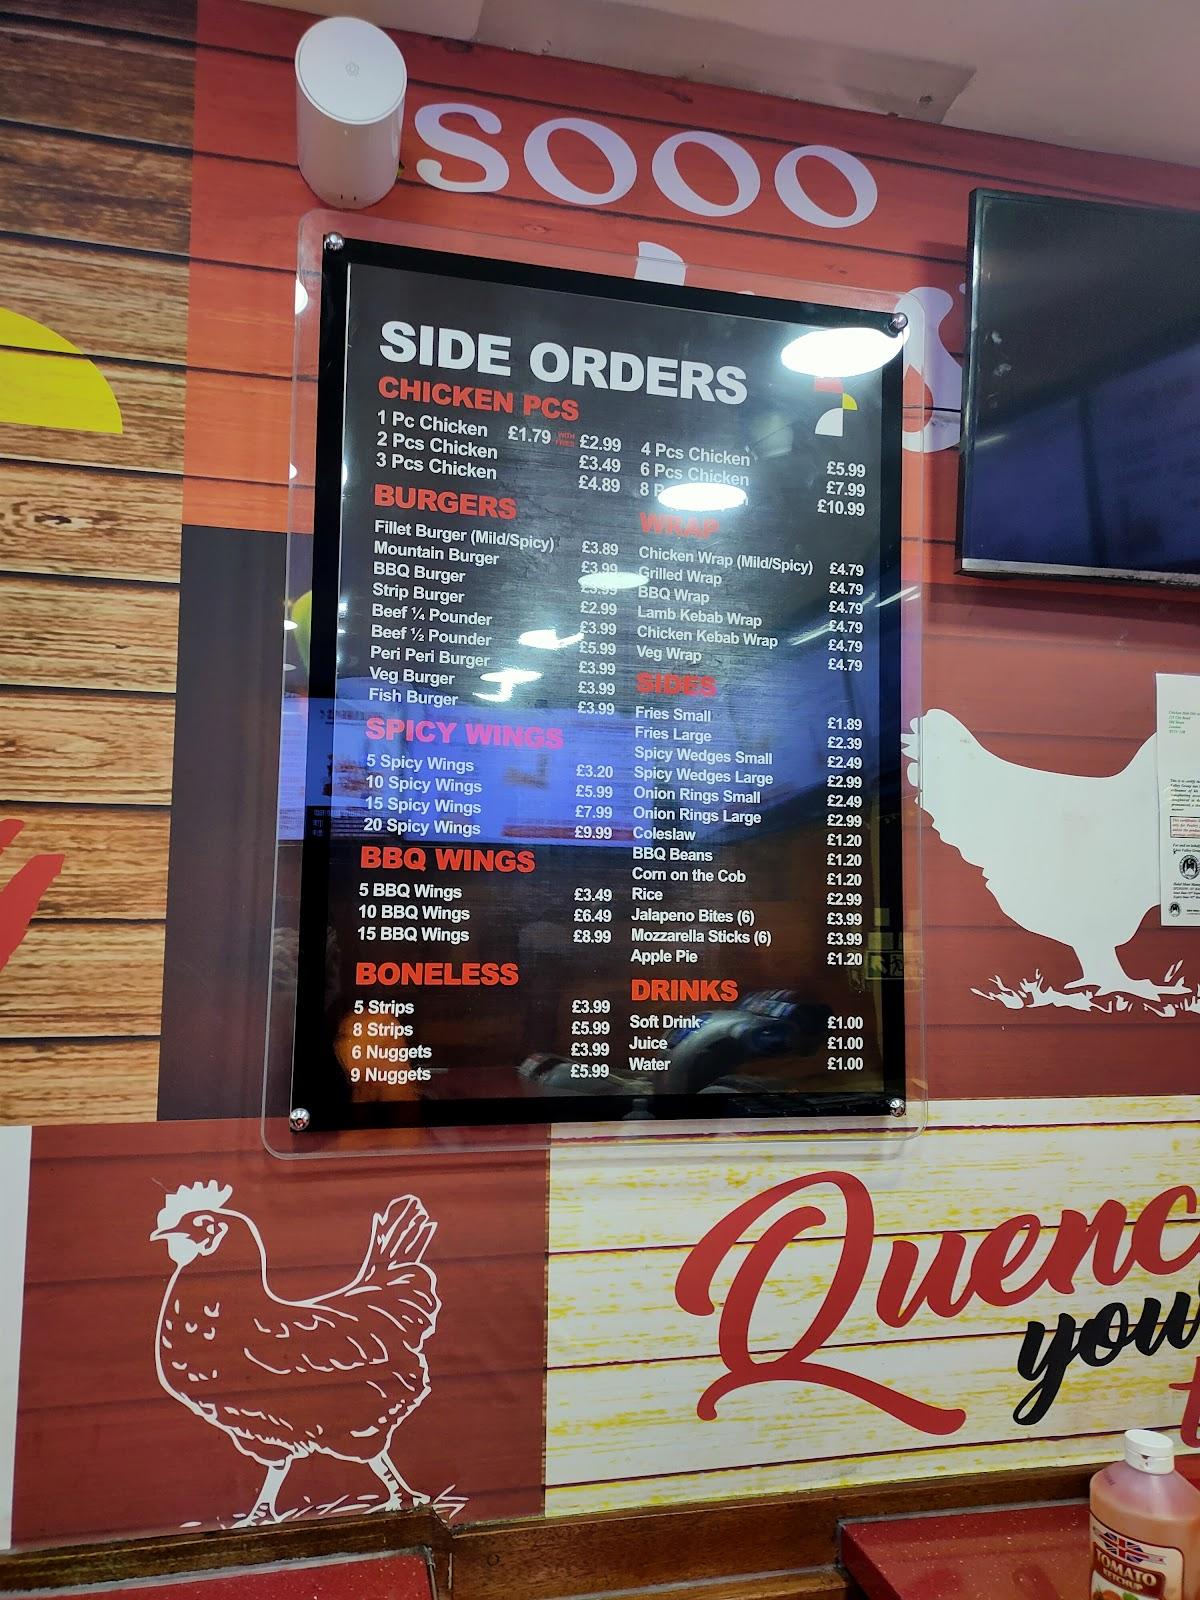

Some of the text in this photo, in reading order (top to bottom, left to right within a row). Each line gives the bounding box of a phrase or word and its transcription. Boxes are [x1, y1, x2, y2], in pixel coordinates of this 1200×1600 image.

[415, 103, 877, 228] SOOO
[380, 321, 748, 405] SIDE ORDERS
[378, 376, 579, 421] CHICKEN PCS
[378, 409, 385, 424] 1
[392, 411, 415, 428] Pc
[420, 415, 487, 437] Chicken
[508, 425, 551, 444] £1.79
[579, 434, 621, 452] £2.99
[377, 431, 620, 473] 2 Pcs Chicken £3.49
[641, 441, 866, 478] 4 Pcs Chicken £5.99
[376, 452, 620, 493] 3 Pcs Chicken £4.89
[374, 483, 517, 519] BURGERS
[817, 499, 865, 517] £10.99
[375, 519, 619, 556] Fillet Burger (Mild/Spicy) £3.89
[640, 512, 718, 538] WRAP
[639, 546, 864, 577] Chicken Wrap (Mild/Spicy) £4.79
[373, 582, 617, 616] Strip Burger £2.99
[372, 603, 408, 619] Beef
[429, 608, 492, 625] Pounder
[580, 621, 617, 637] £3.99
[371, 624, 407, 640] Beef
[428, 628, 492, 646] Pounder
[579, 641, 616, 655] £5.99
[636, 645, 863, 672] Veg Wrap £4.79
[370, 666, 616, 696] Veg Burger £3.99
[636, 672, 717, 697] SIDES
[369, 687, 615, 715] Fish Burger £3.99
[635, 705, 862, 731] Fries Small £1.89
[367, 716, 563, 749] SPICY WINGS
[635, 725, 862, 750] Fries Large £2.39
[366, 753, 613, 778] 5 Spicy Wings £3.20
[634, 746, 862, 769] Spicy Wedges Small £2.49
[366, 775, 613, 799] 10 Spicy Wings £5.99
[634, 786, 862, 808] Onion Rings Small £2.49
[363, 817, 612, 840] 20 Spicy Wings £9.99
[634, 806, 862, 827] Onion Rings Large £2.99
[633, 826, 862, 847] Coleslaw £1.20
[361, 845, 535, 873] BBQ WINGS
[633, 846, 862, 867] BBQ Beans £1.20
[632, 867, 862, 886] Corn on the Cob £1.20
[359, 882, 612, 902] 5 BBQ Wings £3.49
[632, 887, 862, 906] Rice £2.99
[359, 904, 612, 923] 10 BBQ Wings £6.49
[631, 907, 862, 926] Jalapeno Bites (6) £3.99
[357, 926, 611, 945] 15 BBQ Wings £8.99
[632, 928, 862, 946] Mozzarella Sticks (6) £3.99
[630, 949, 863, 966] Apple Pie £1.20
[356, 962, 519, 987] BONELESS
[631, 978, 738, 1002] DRINKS
[354, 1000, 610, 1018] 5 Strips £3.99
[353, 1021, 610, 1040] 8 Strips £5.99
[630, 1014, 863, 1030] Soft Drink £1.00
[352, 1042, 610, 1062] 6 Nuggets £3.99
[629, 1036, 863, 1050] Juice £1.00
[350, 1064, 609, 1085] 9 Nuggets £5.99
[629, 1057, 864, 1071] Water £1.00
[1013, 1282, 1200, 1425] you
[1096, 1549, 1157, 1586] TOMATO
